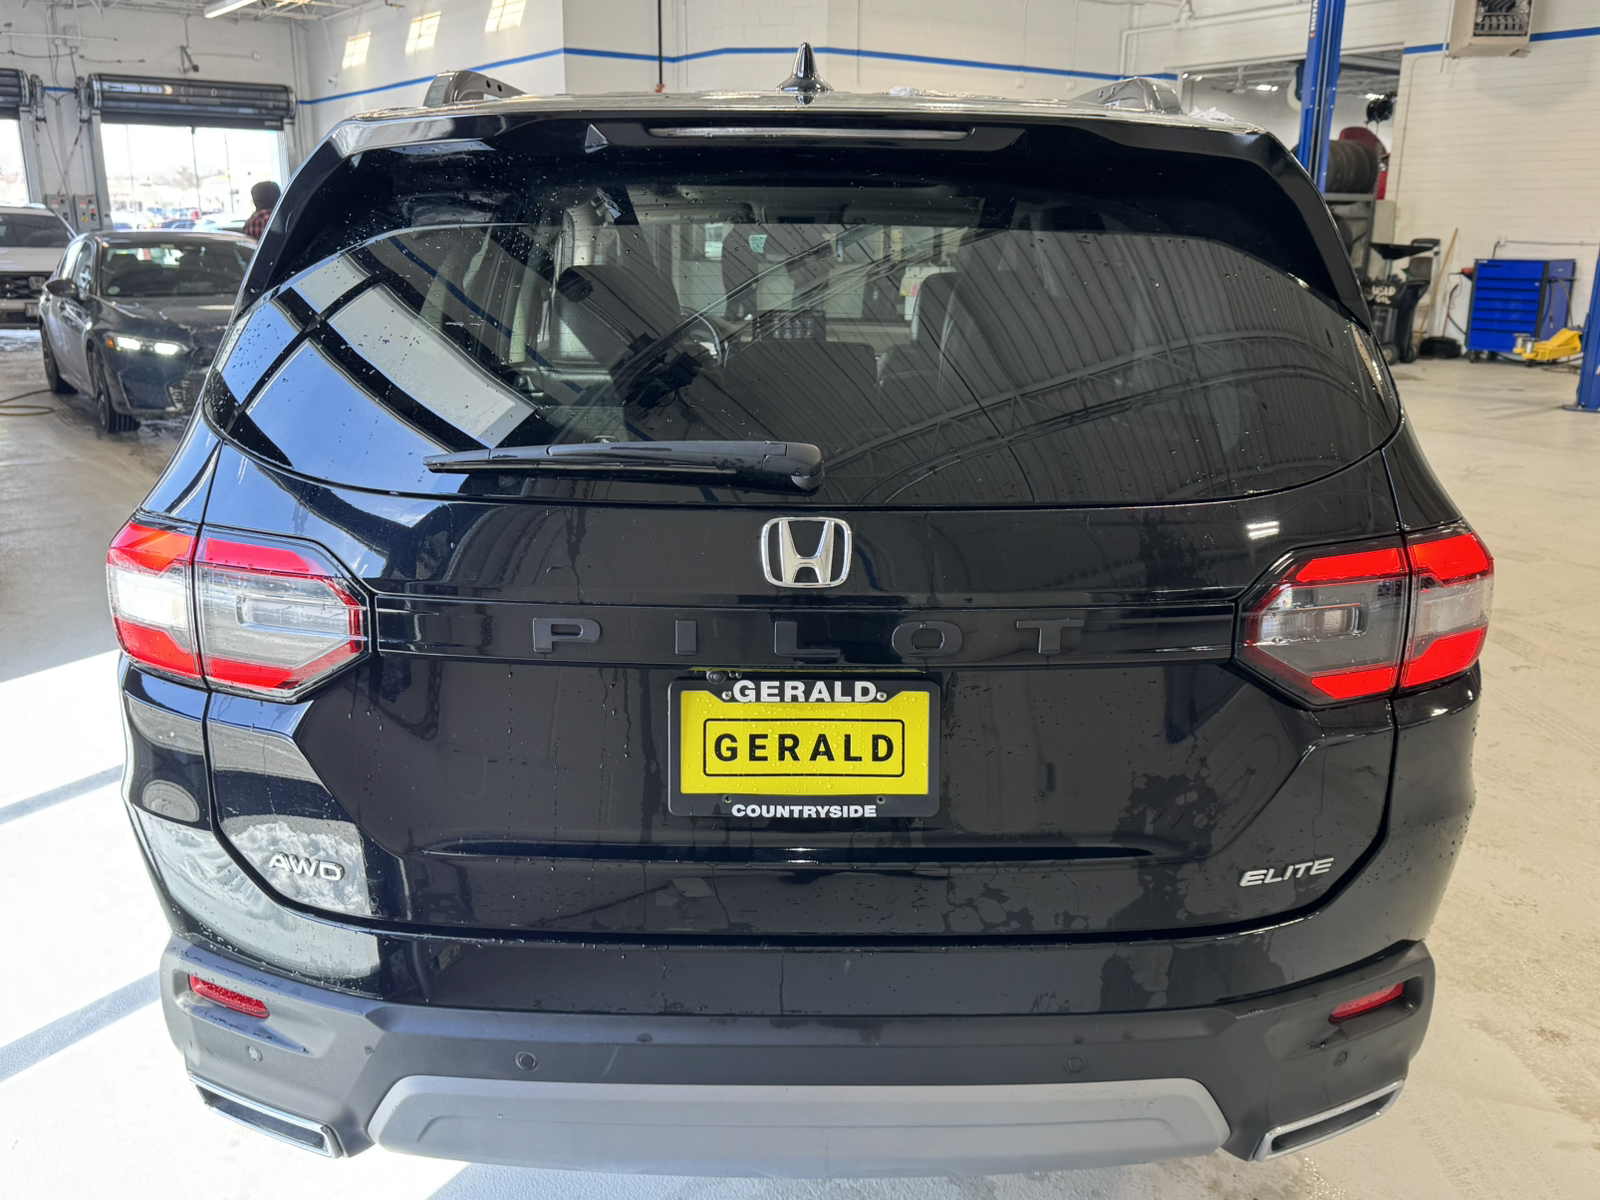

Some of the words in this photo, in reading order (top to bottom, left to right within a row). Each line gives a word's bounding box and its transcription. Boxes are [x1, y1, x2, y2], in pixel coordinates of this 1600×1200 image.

[533, 617, 1085, 657] PILOT
[732, 680, 877, 703] GERALD
[713, 733, 895, 762] GERALD
[731, 804, 877, 818] COUNTRYSIDE
[268, 852, 345, 881] AWD
[1239, 857, 1335, 887] ELITE
